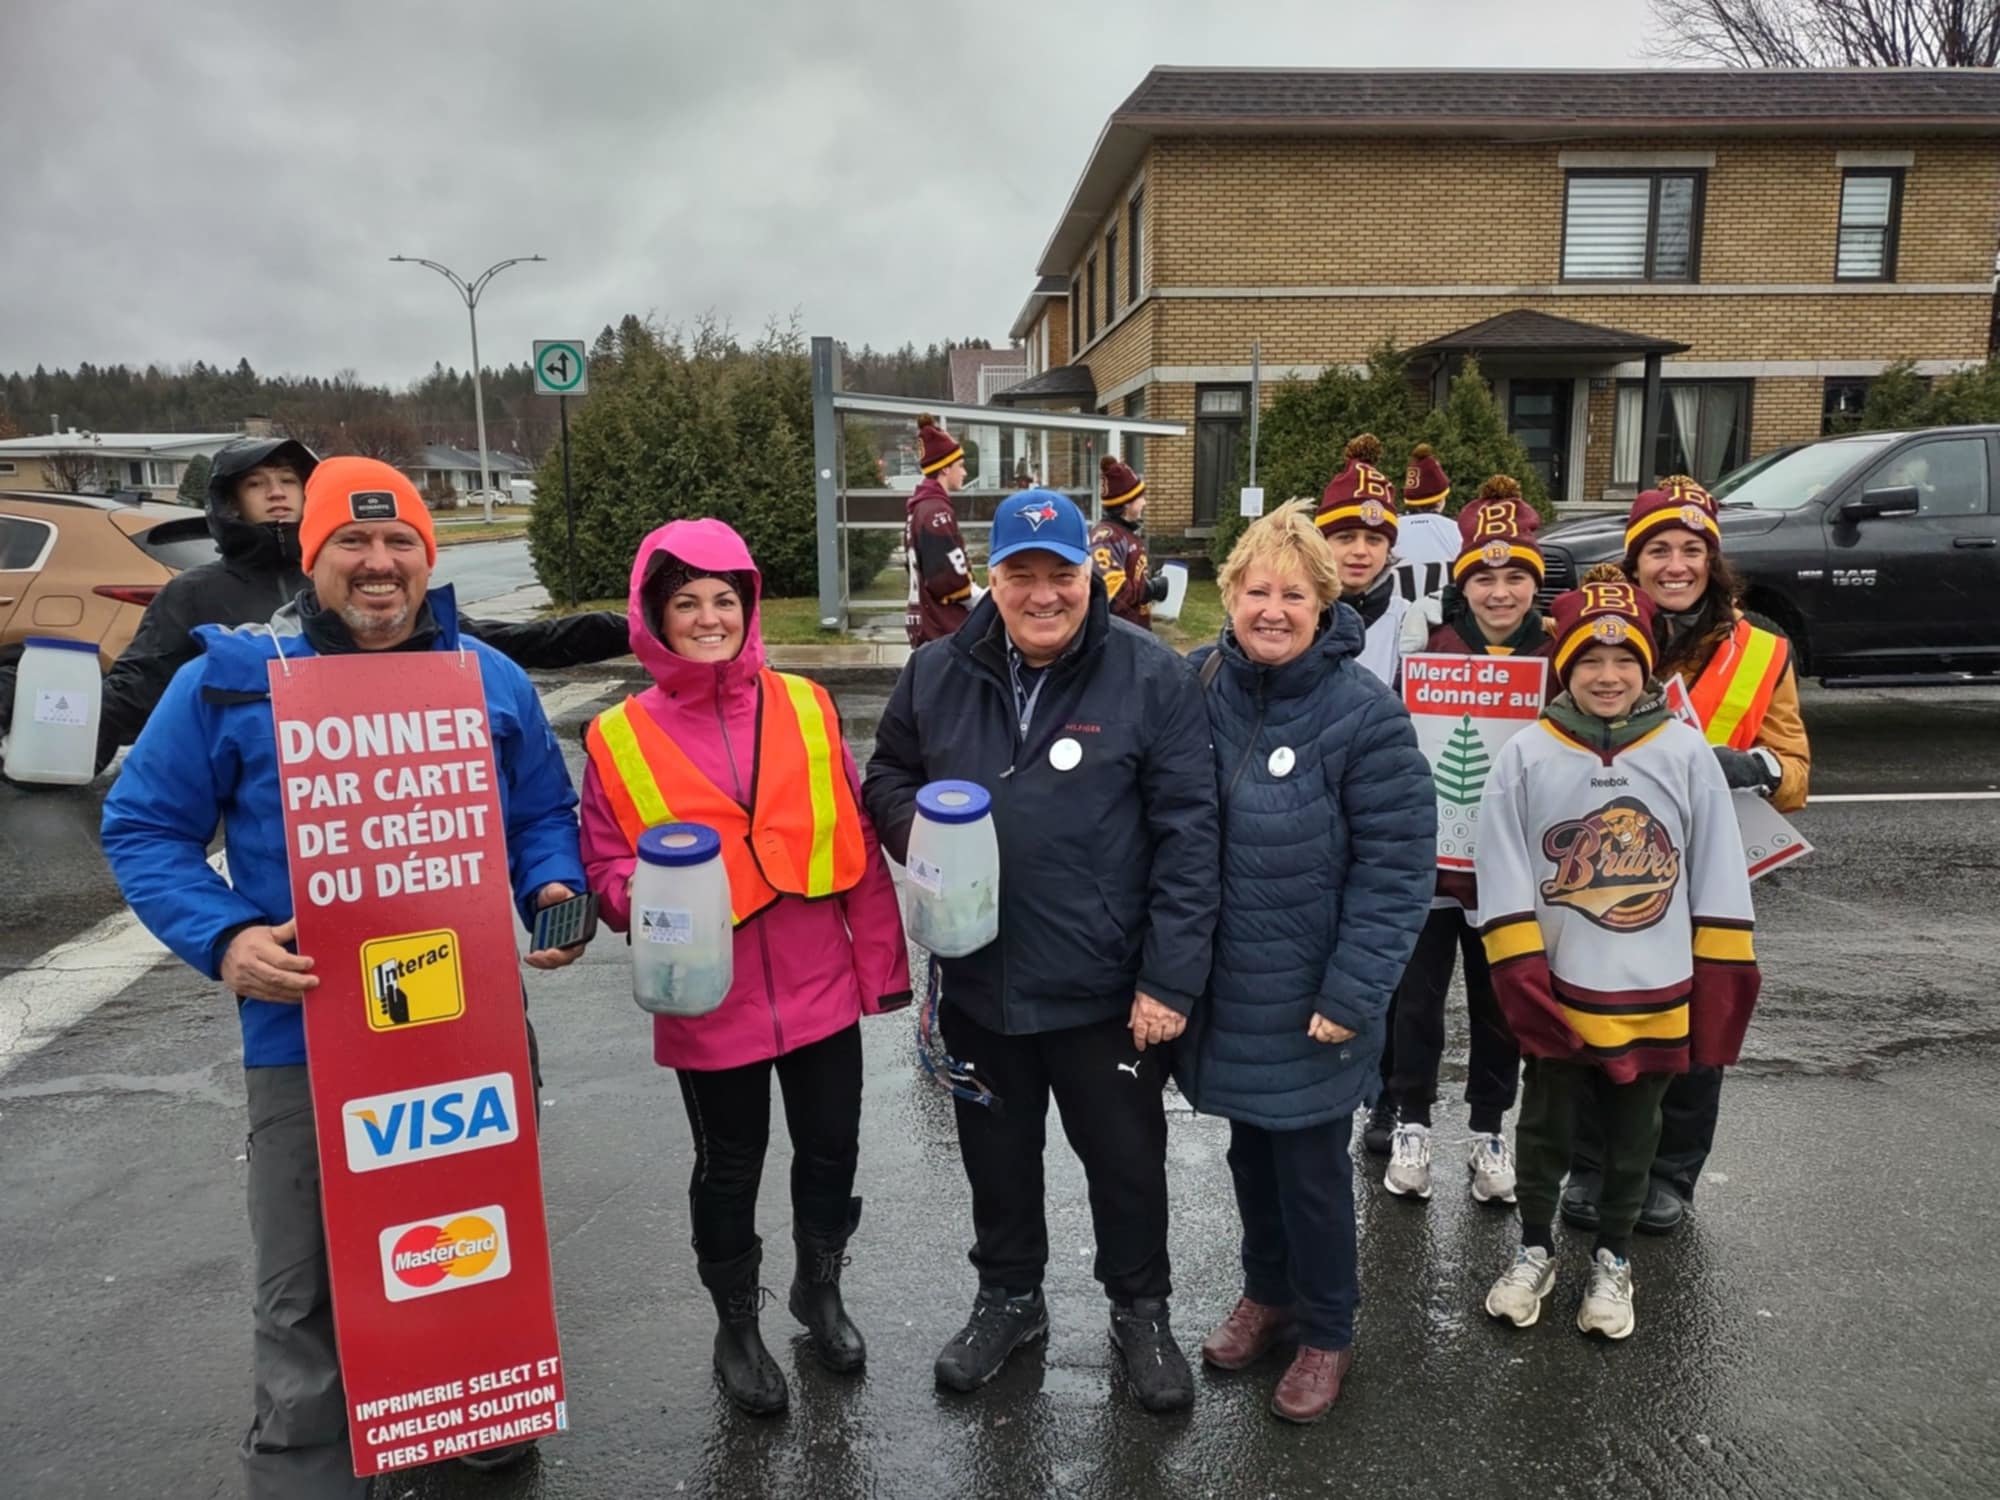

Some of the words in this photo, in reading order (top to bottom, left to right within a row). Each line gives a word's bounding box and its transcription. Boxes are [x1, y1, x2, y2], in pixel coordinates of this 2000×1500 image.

[1473, 501, 1519, 542] B
[1832, 569, 1877, 577] RAM
[1832, 577, 1876, 586] 1500
[1580, 582, 1639, 617] B
[1408, 661, 1471, 682] Merci
[1477, 663, 1510, 683] de
[1416, 684, 1504, 706] donner
[1509, 693, 1541, 707] au
[278, 708, 488, 764] DONNER
[287, 772, 362, 810] PAR
[373, 760, 488, 800] CARTE
[1590, 776, 1629, 788] Reebok
[297, 820, 349, 859] DE
[361, 803, 488, 850] CRÉDIT
[308, 867, 362, 906] OU
[375, 851, 484, 897] DÉBIT
[1543, 821, 1679, 894] Braves
[377, 943, 450, 990] Interac
[349, 1086, 510, 1157] VISA
[395, 1233, 495, 1272] MasterCard
[356, 1381, 464, 1422] IMPRIMERIE
[468, 1364, 531, 1394] SELECT
[537, 1357, 558, 1378] ET
[367, 1408, 463, 1445] CAMELEON
[468, 1385, 556, 1421] SOLUTION
[376, 1444, 429, 1470] FIERS
[433, 1412, 553, 1456] PARTENAIRES
